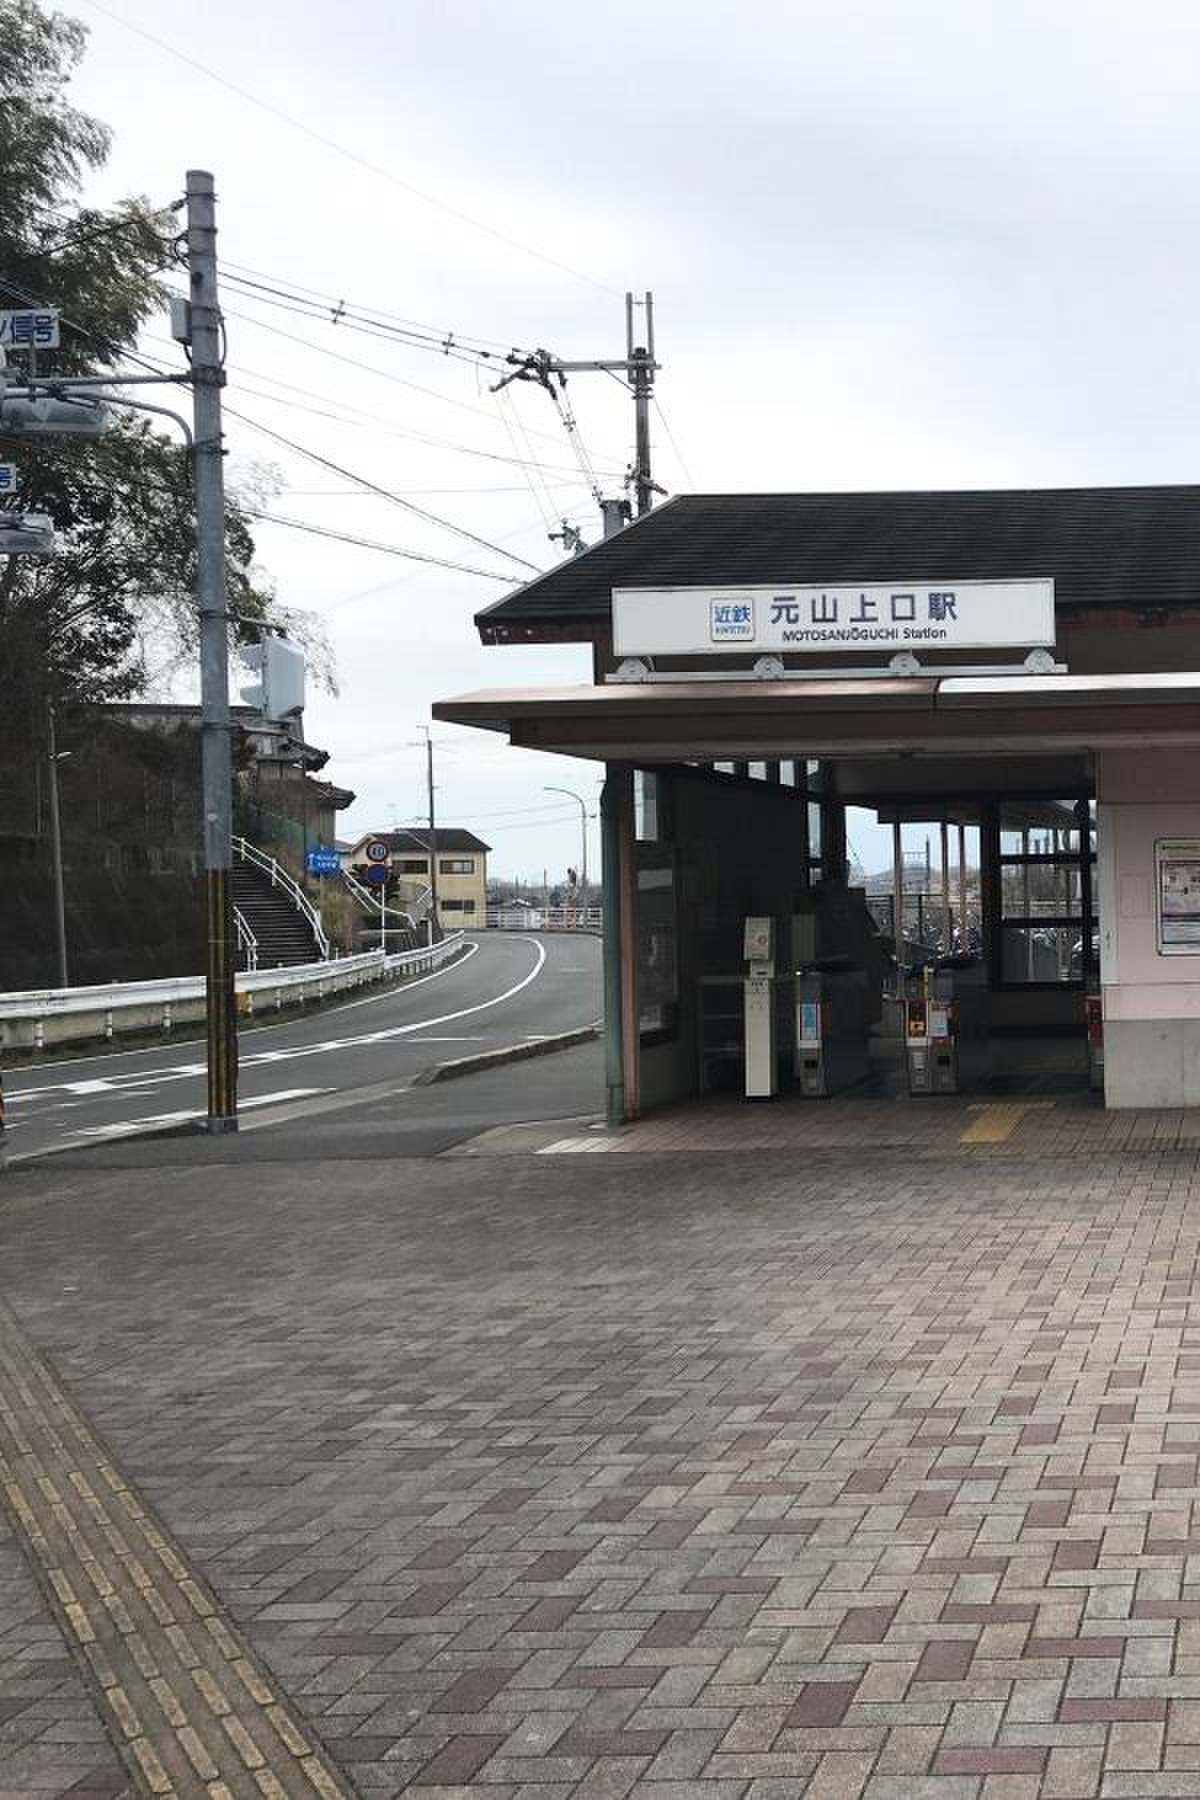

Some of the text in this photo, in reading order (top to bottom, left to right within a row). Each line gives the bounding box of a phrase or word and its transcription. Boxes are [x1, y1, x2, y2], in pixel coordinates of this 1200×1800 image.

[714, 605, 751, 623] 近鉄
[770, 592, 957, 624] 元山上口駅
[903, 627, 947, 639] Station
